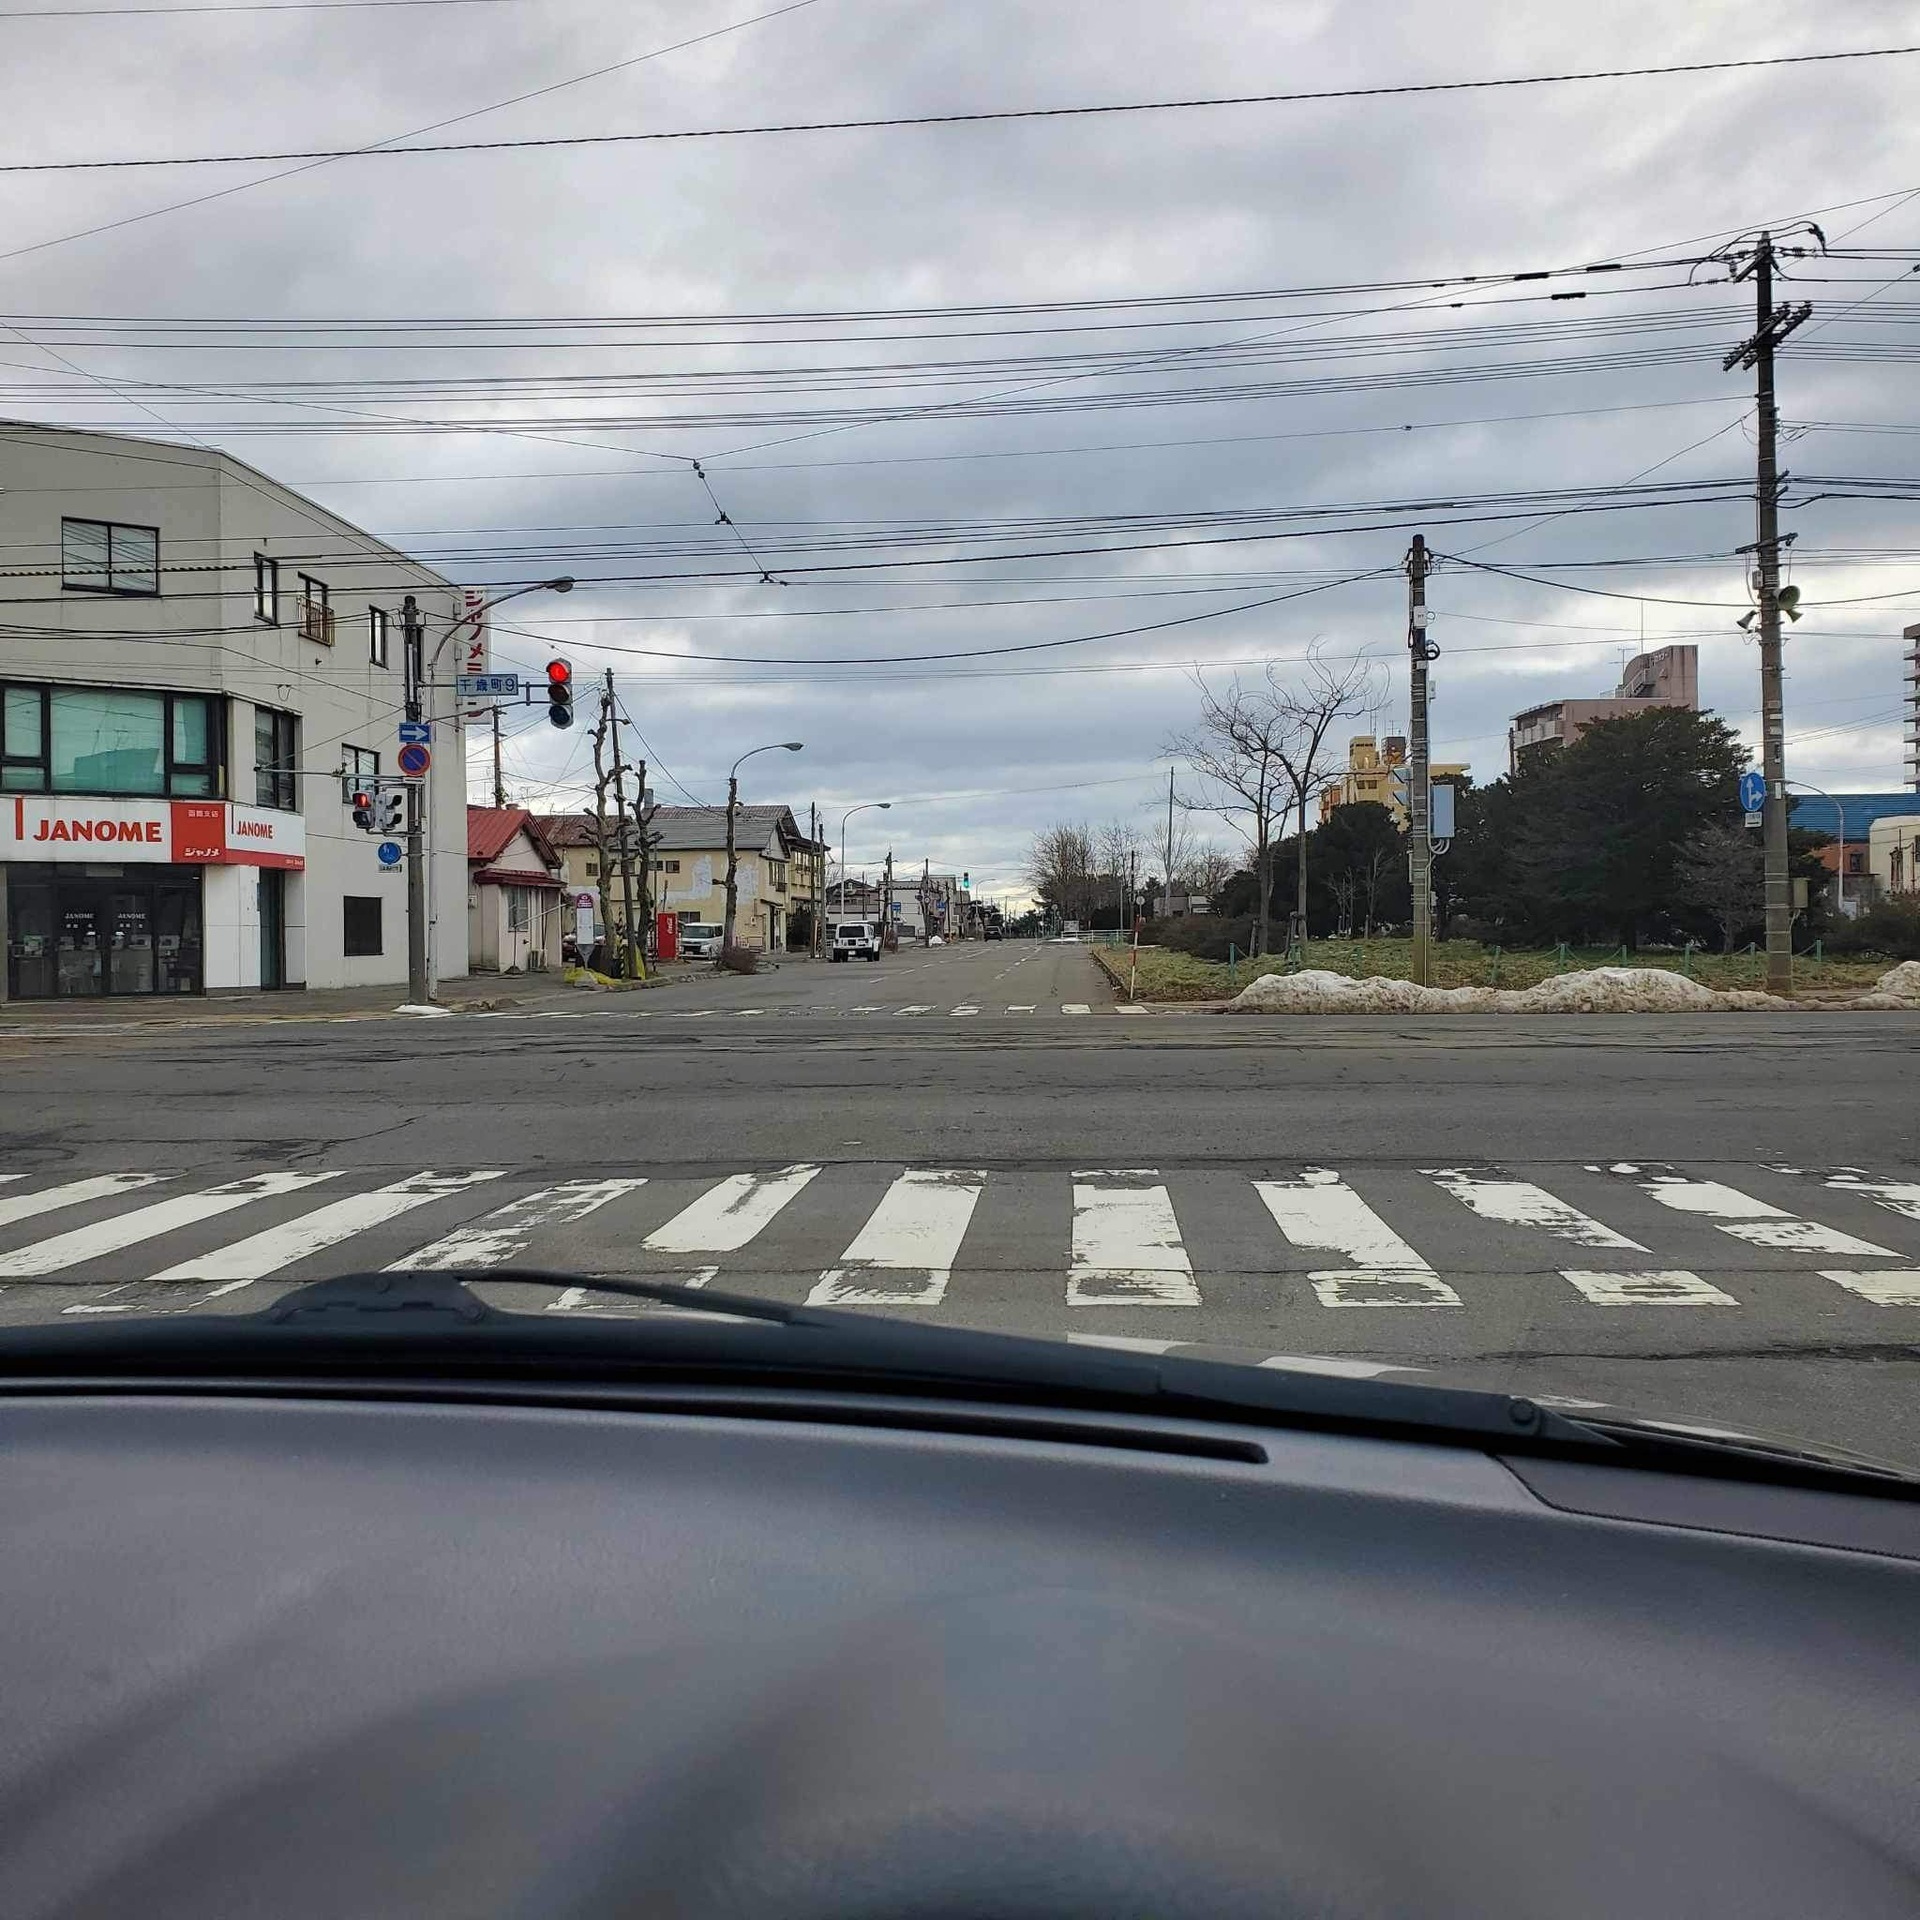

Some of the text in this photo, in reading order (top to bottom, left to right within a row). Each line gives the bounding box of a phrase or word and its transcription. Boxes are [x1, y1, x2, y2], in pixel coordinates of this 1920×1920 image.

[465, 589, 484, 718] ジャノメミン
[33, 819, 162, 842] JANOME
[236, 820, 273, 839] JANOME
[184, 847, 220, 857] ジャノメ
